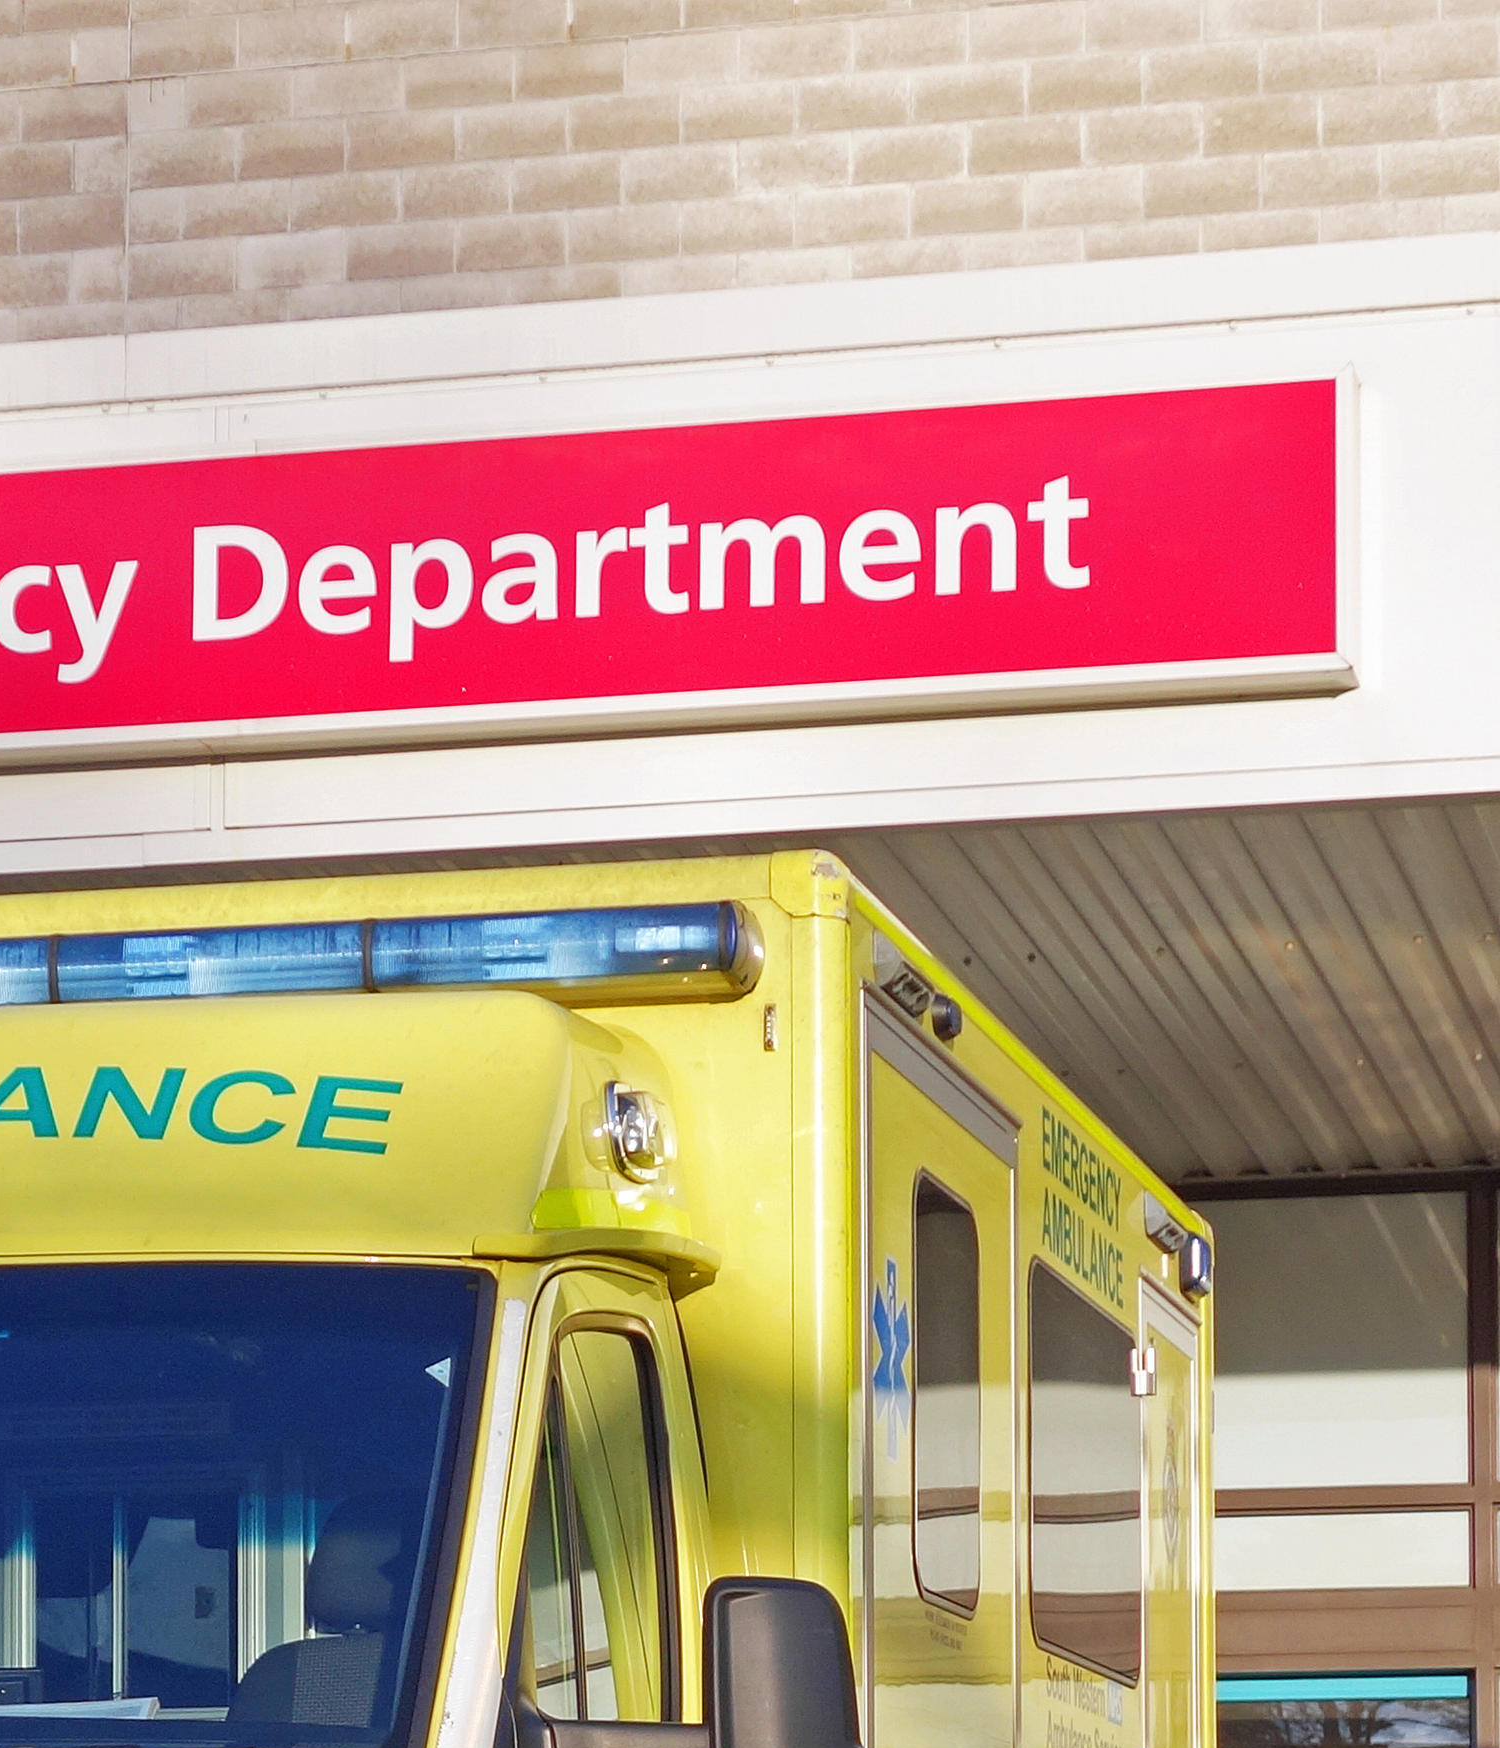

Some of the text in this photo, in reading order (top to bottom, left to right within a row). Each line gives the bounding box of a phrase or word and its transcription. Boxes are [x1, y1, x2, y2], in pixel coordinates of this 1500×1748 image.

[192, 475, 1091, 662] Department
[1041, 1104, 1121, 1232] EMERGENCY
[1042, 1187, 1124, 1309] AMBULANCE
[1046, 1656, 1071, 1704] South
[1073, 1666, 1105, 1717] Western
